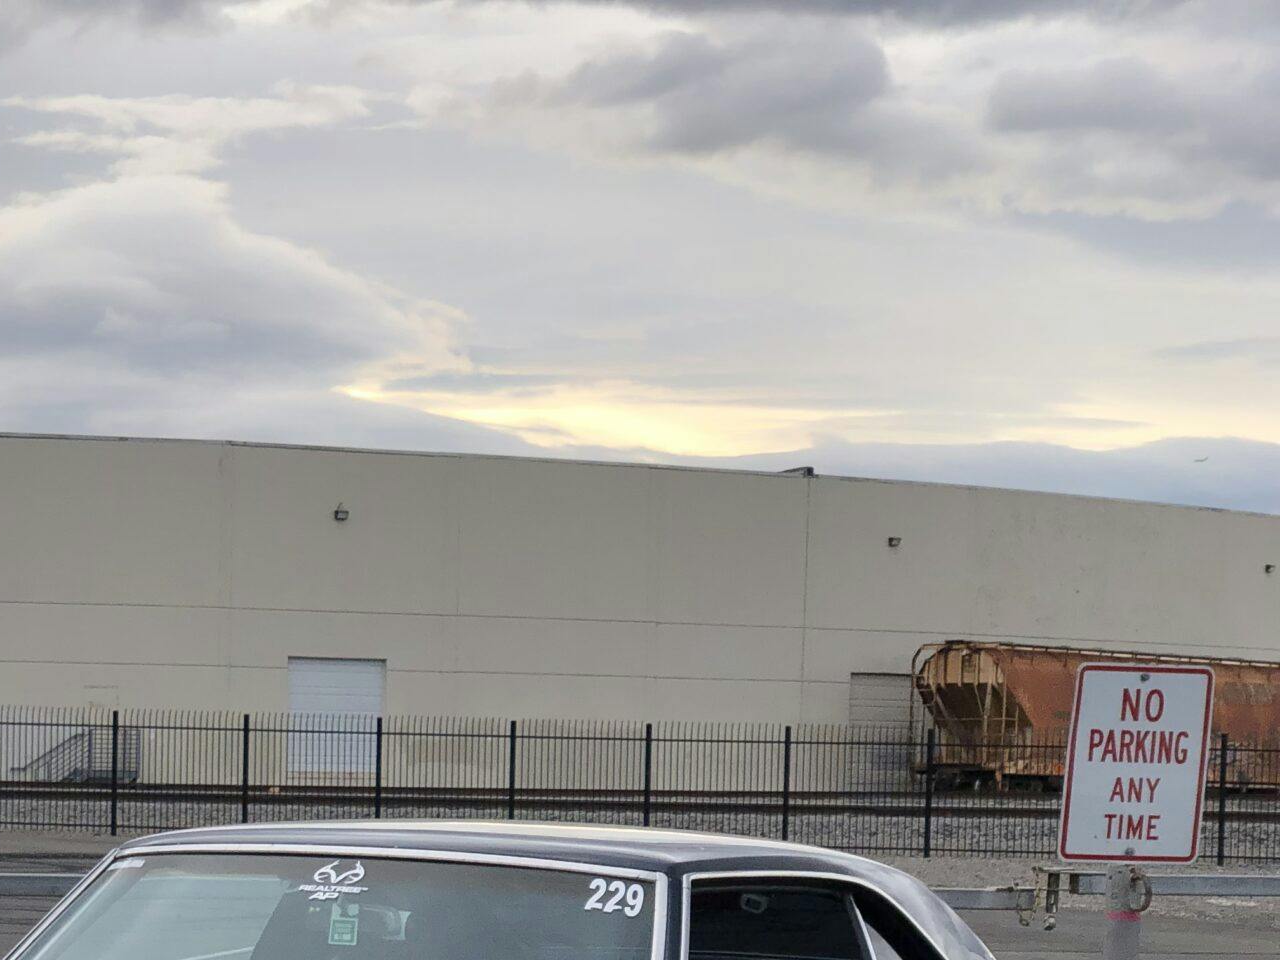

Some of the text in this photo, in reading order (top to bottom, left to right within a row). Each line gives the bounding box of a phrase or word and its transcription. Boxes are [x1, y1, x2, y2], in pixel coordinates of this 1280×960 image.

[1120, 688, 1165, 722] NO
[1088, 729, 1189, 764] PARKING
[1109, 777, 1161, 803] ANY
[1104, 814, 1161, 840] TIME
[308, 891, 340, 900] AP
[584, 878, 644, 917] 229
